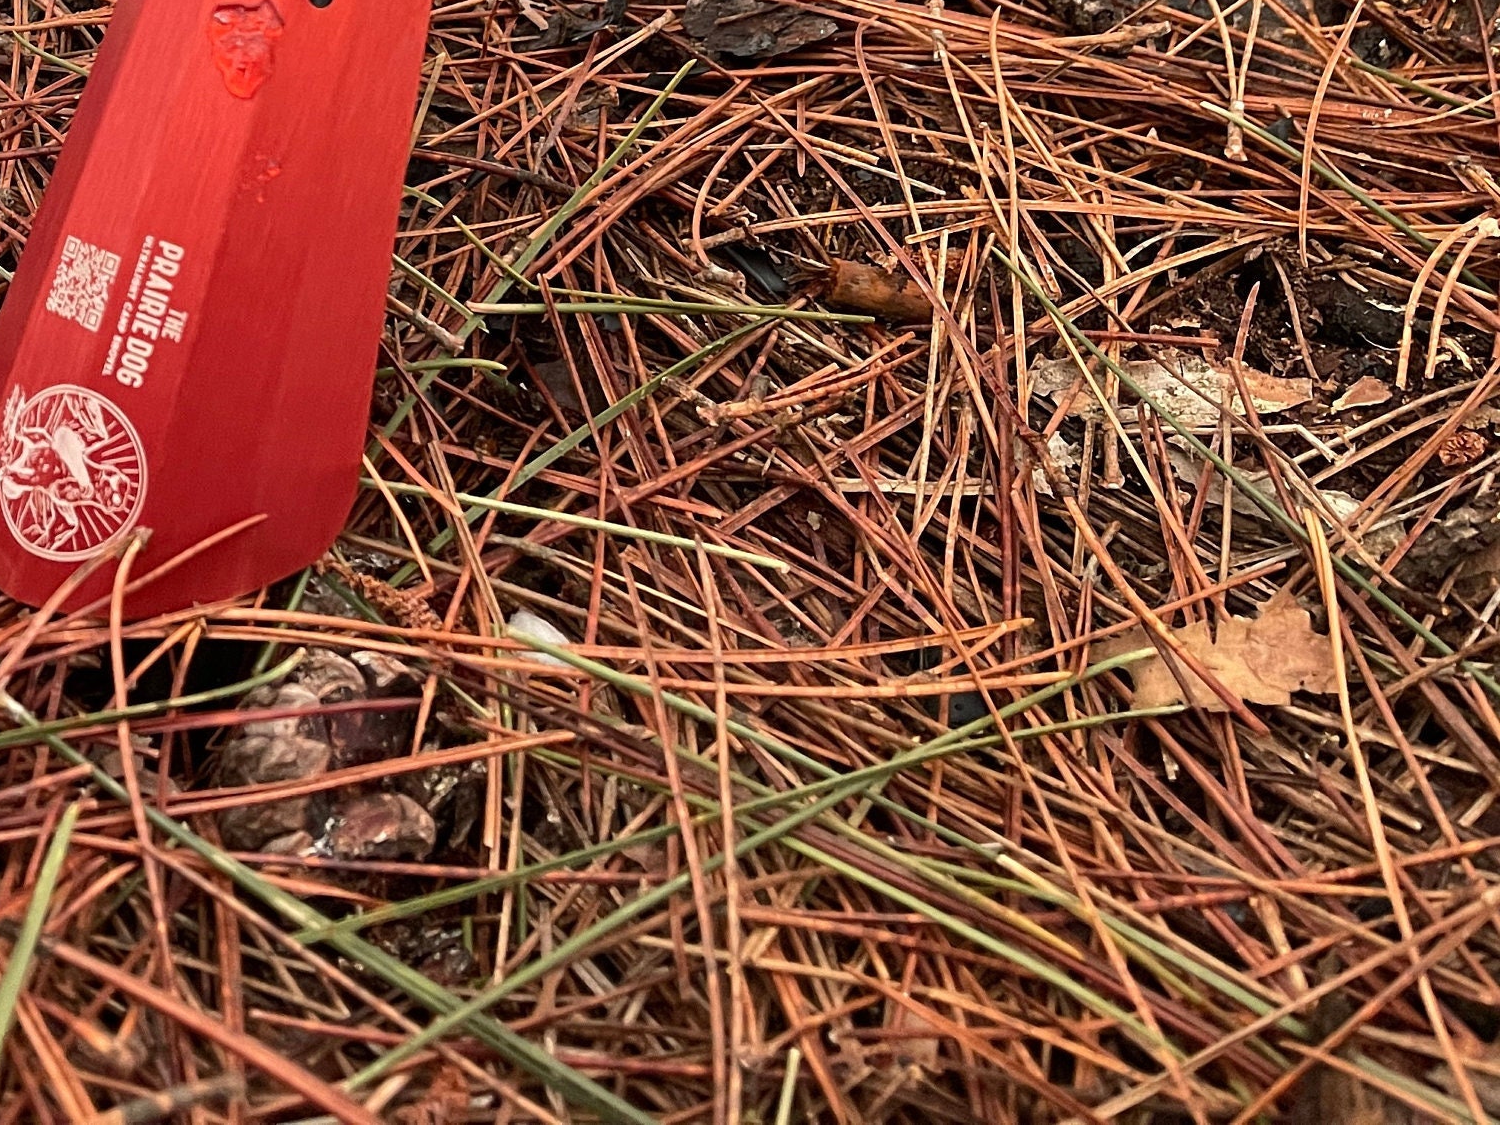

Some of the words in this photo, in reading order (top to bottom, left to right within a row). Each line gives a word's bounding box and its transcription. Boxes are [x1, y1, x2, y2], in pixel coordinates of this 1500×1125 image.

[131, 240, 185, 341] PRAIRIE
[161, 307, 189, 343] THE
[116, 336, 155, 389] DOG
